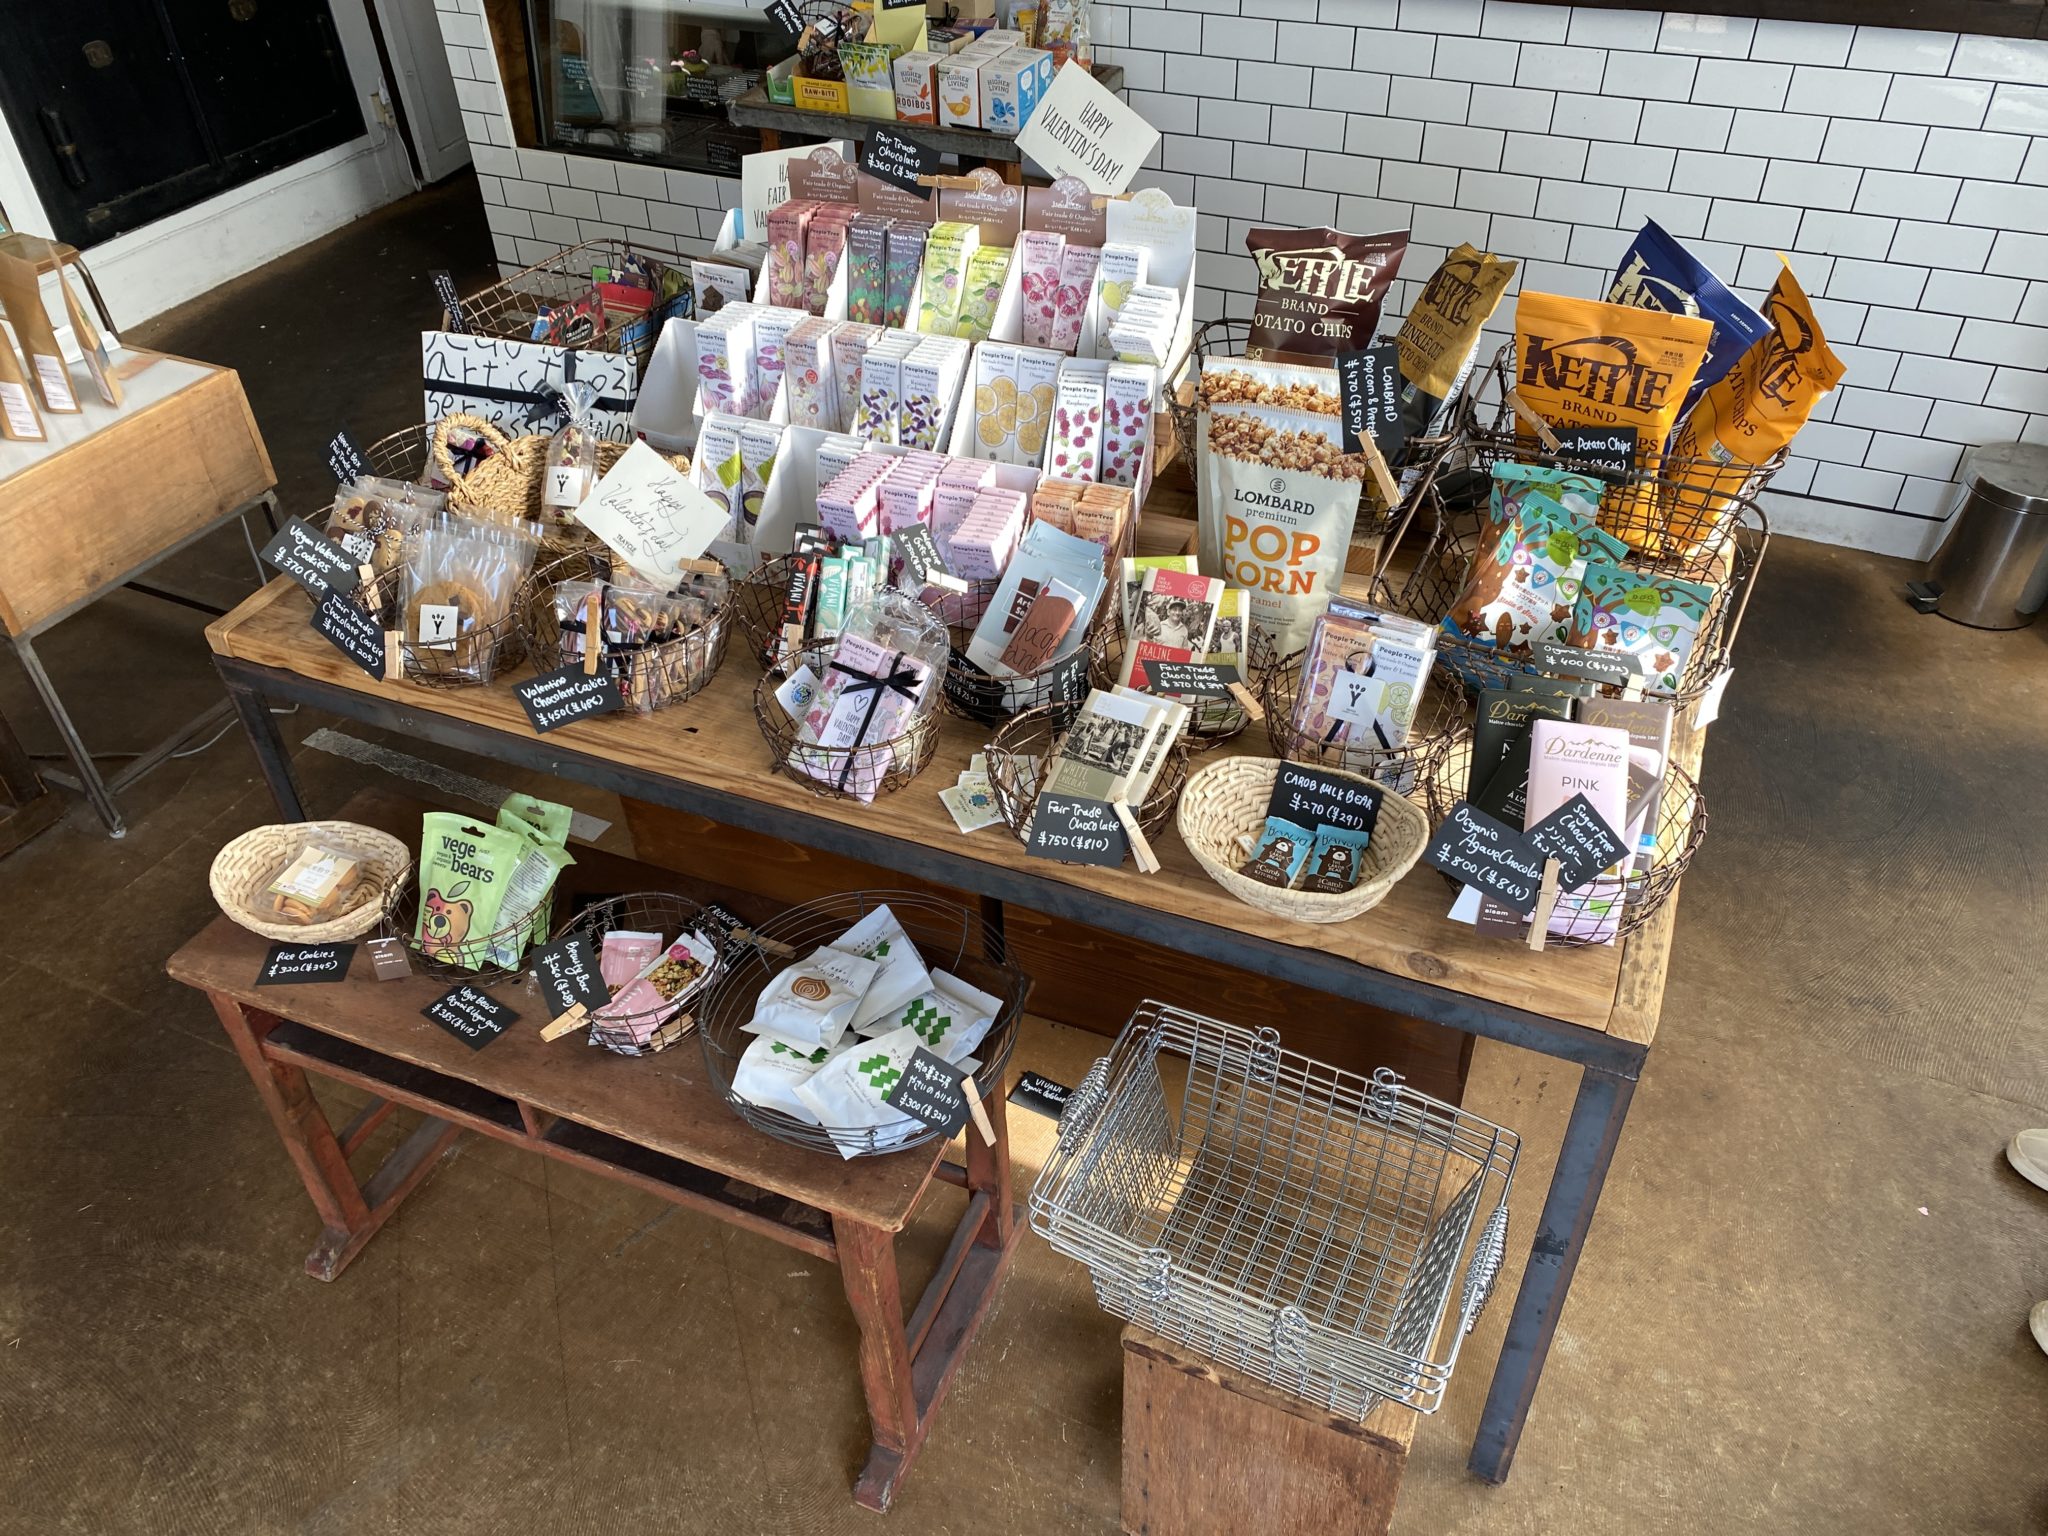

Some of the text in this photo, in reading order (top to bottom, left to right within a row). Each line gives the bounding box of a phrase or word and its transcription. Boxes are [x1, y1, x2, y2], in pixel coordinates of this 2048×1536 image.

[901, 71, 922, 81] HIGHER
[902, 78, 921, 86] LIVING
[947, 74, 970, 83] HIGHER
[947, 80, 968, 90] LIVING
[987, 78, 1012, 88] HIGHER
[989, 85, 1010, 94] LIVING
[897, 96, 931, 110] ROOIBOS
[1078, 100, 1113, 140] HAPPY
[876, 131, 917, 154] Fair Trade
[878, 146, 921, 168] Chocolate
[700, 272, 716, 284] People
[1251, 247, 1378, 304] KETTLE
[1281, 297, 1329, 316] BRAND
[1253, 313, 1353, 340] OTATO CHIPS
[1420, 314, 1444, 336] BRAND
[1400, 320, 1430, 354] RINKLE
[865, 359, 882, 368] People
[982, 351, 1000, 360] People
[904, 366, 922, 374] People
[1520, 332, 1674, 417] KETTLE
[1066, 400, 1090, 408] Raspberry
[1115, 390, 1140, 399] Raspberry
[1344, 358, 1364, 436] ¥470 (¥507)
[1382, 366, 1398, 422] LOMBARD
[1561, 398, 1618, 424] BRAND
[1732, 402, 1759, 437] CHIPS
[338, 432, 352, 455] Heart
[1577, 436, 1606, 452] Potato
[1607, 436, 1632, 455] Chips
[647, 476, 687, 526] Happy
[1234, 488, 1316, 517] LOMBARD
[1245, 506, 1298, 526] premium
[289, 525, 352, 573] Vegan Valentine
[616, 533, 637, 554] TRAYCLE
[920, 528, 942, 566] Valentine
[1224, 514, 1322, 566] POP
[293, 544, 332, 574] Cookies
[1224, 554, 1317, 596] CORN
[332, 594, 374, 637] Fair Trade
[322, 617, 346, 642] ¥190
[322, 602, 384, 658] Chocolate Cookie
[1326, 632, 1366, 648] People Tree
[846, 639, 880, 658] People Tree
[1139, 644, 1172, 661] PRALINE
[1379, 646, 1422, 662] People Tree
[1543, 644, 1579, 656] Organic
[1159, 664, 1216, 674] Fair Trade
[1544, 655, 1630, 675] ¥400 (¥432)
[532, 675, 608, 709] Chocolate Cookies
[537, 705, 568, 728] ¥450
[846, 712, 860, 724] HAPPY
[1544, 736, 1622, 764] Dardenne
[1062, 762, 1089, 779] WHITE
[1058, 775, 1088, 790] CHOCOLATE
[1284, 771, 1318, 791] CAROB
[1345, 789, 1373, 811] BEAR
[1561, 776, 1600, 792] PINK
[1047, 801, 1102, 818] Fair Trade
[1289, 792, 1364, 830] ¥270 (¥291)
[1068, 816, 1120, 832] Chocolate
[1454, 808, 1498, 842] Organic
[1573, 803, 1616, 854] Sugar Free
[442, 836, 476, 860] vege
[1037, 831, 1110, 852] ¥750 (¥810)
[1267, 826, 1309, 847] BANJO
[1559, 814, 1602, 860] Chocolate
[1458, 832, 1544, 881] Agave Chocolat
[450, 853, 495, 884] bears
[1436, 842, 1530, 901] ¥800 (¥864)
[276, 950, 335, 962] Rice Cookies
[542, 952, 561, 980] ¥260
[268, 960, 338, 978] ¥320 (¥345)
[564, 940, 590, 996] Beauty Bar
[460, 986, 499, 1014] Vege Bears
[431, 1003, 480, 1037] ¥385 (¥415)
[1034, 1078, 1063, 1094] VIVANI
[899, 1092, 952, 1126] ¥300 (¥324)
